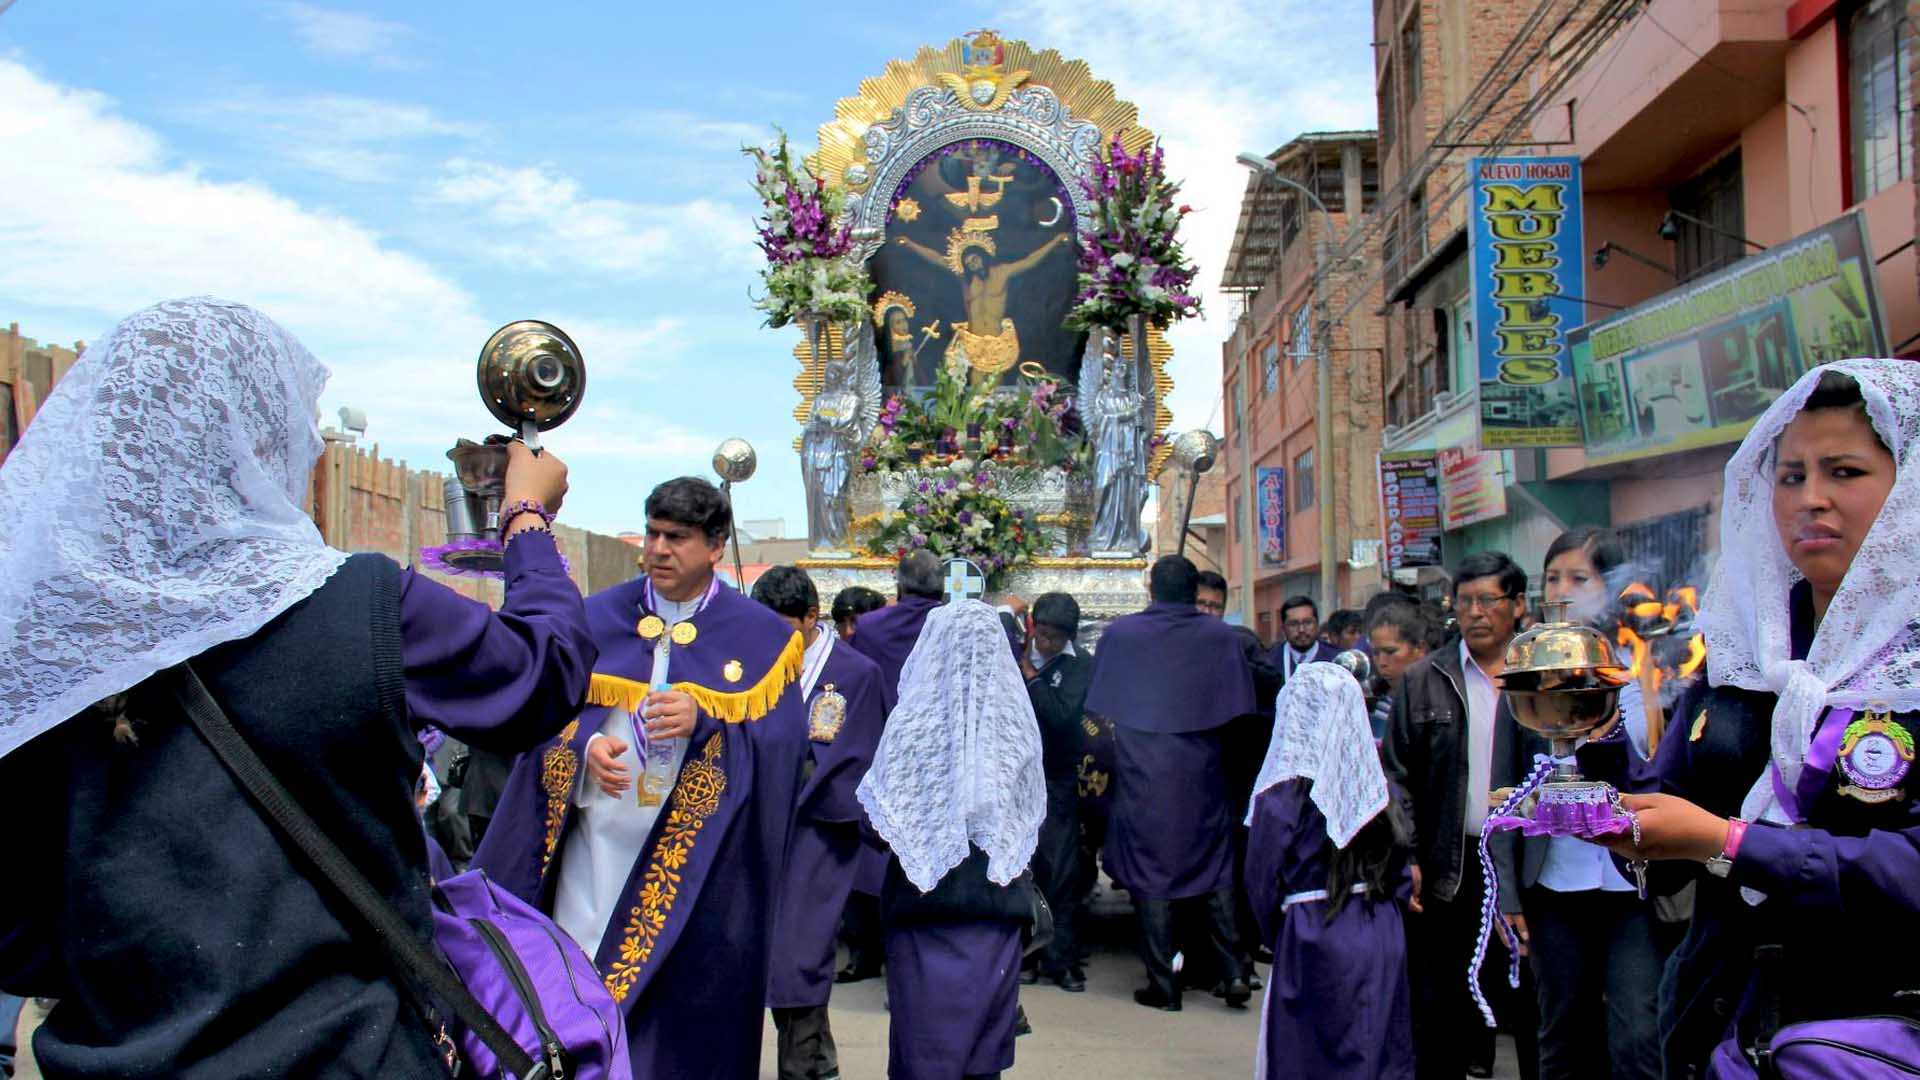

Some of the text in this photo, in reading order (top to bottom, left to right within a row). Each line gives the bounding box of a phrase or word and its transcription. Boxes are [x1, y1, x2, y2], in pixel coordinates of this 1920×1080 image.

[1480, 164, 1571, 179] NUEVO HOGAR
[1482, 184, 1565, 386] MUEBLES
[1264, 474, 1281, 554] ALADIN
[1383, 471, 1404, 568] BORDADOS
